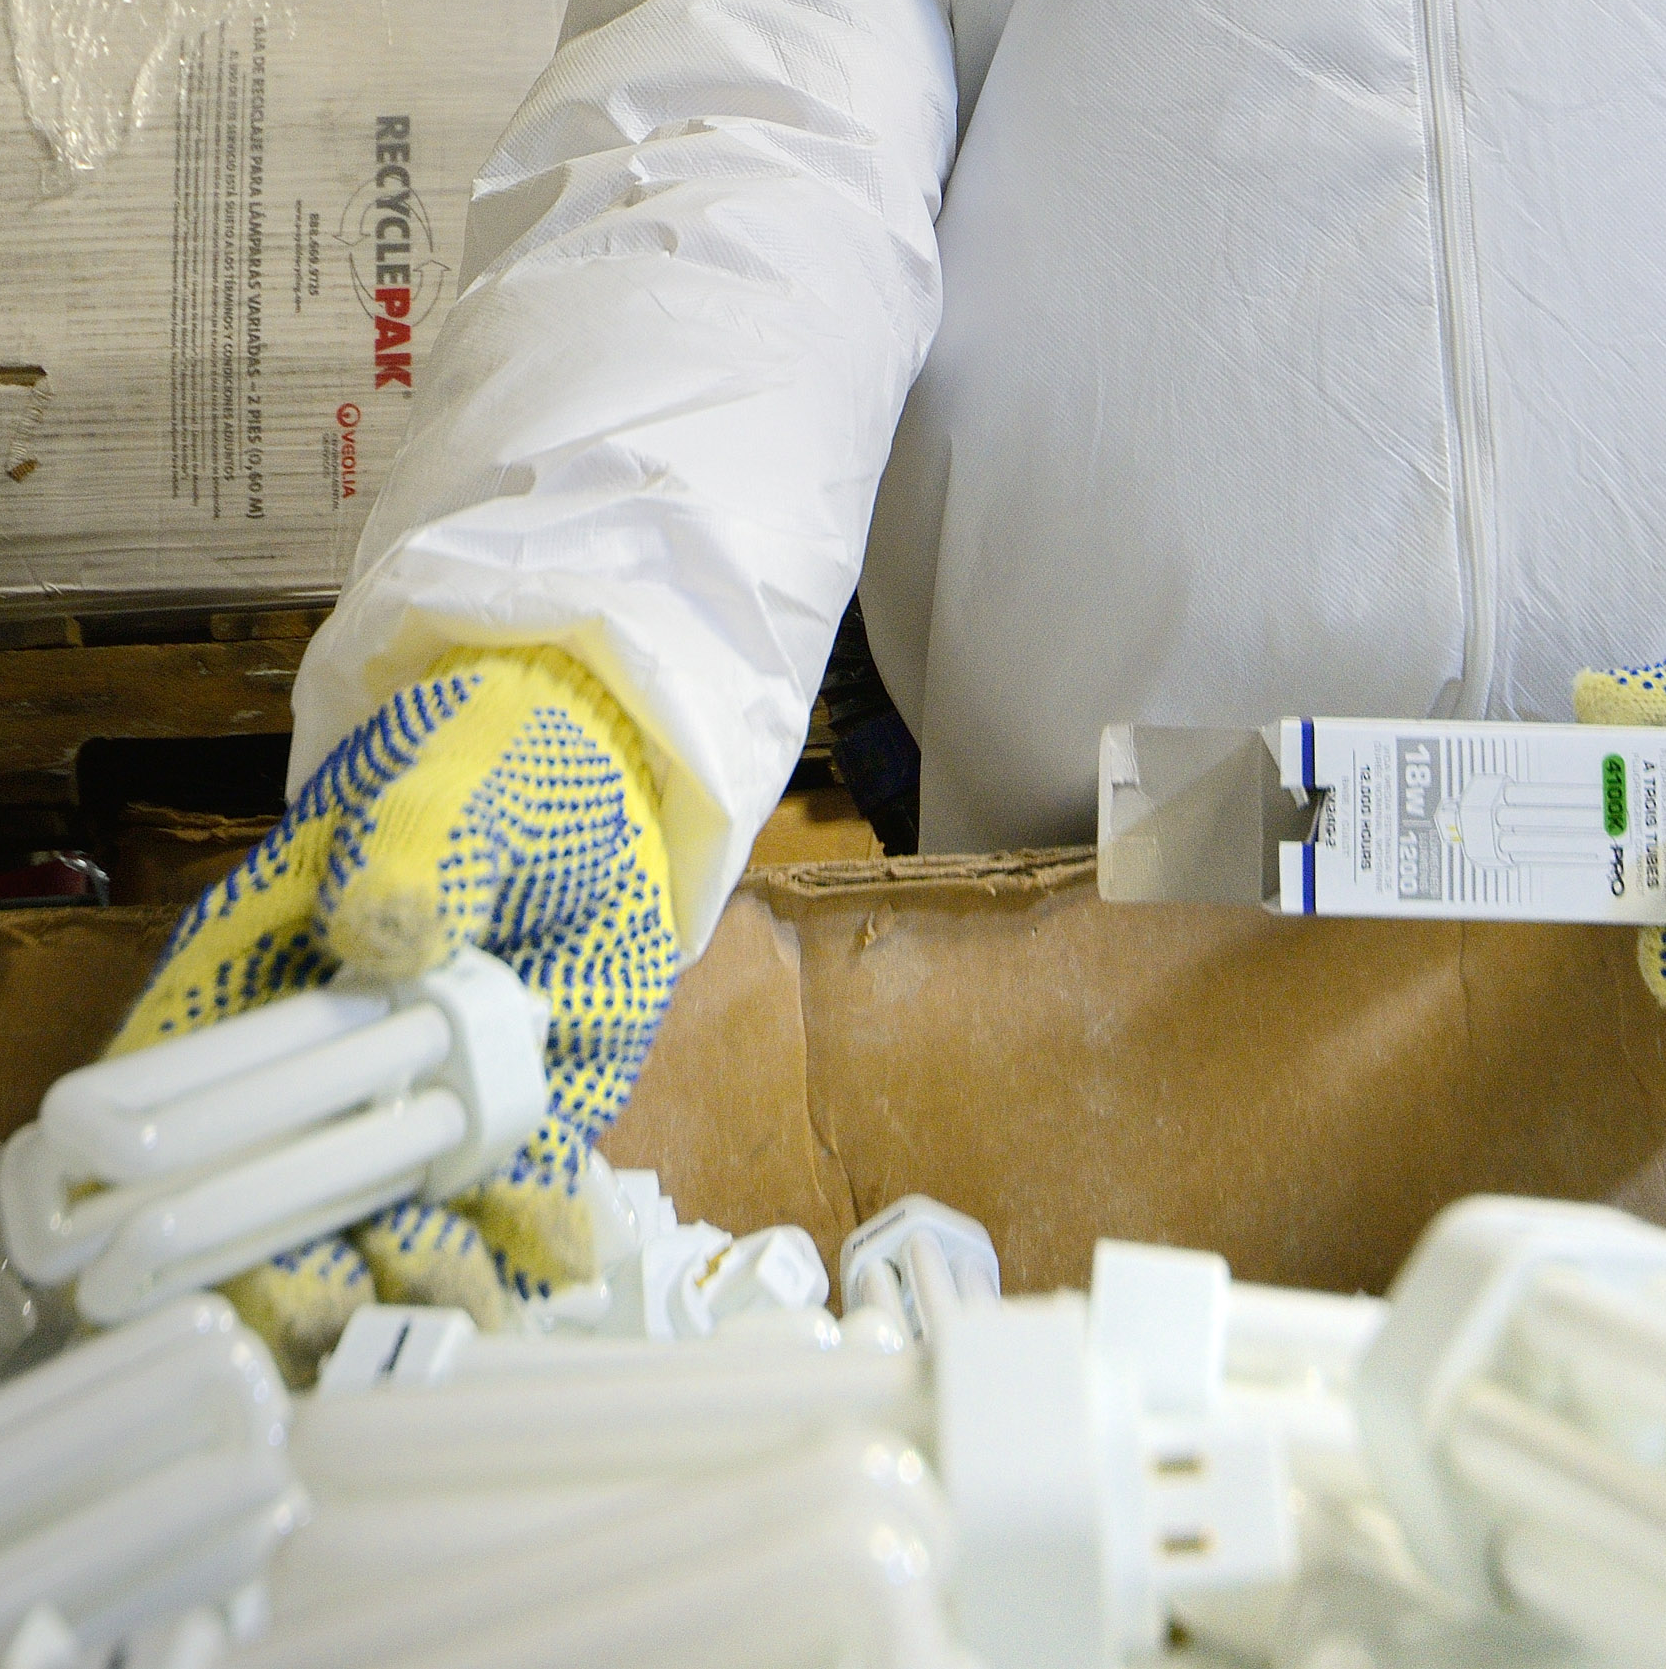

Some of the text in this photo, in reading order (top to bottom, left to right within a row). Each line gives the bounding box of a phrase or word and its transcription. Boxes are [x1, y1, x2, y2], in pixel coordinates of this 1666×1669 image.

[250, 77, 265, 151] RECICLAJE
[248, 153, 263, 197] PARA
[247, 201, 266, 292] LÁMPARAS
[374, 114, 412, 390] RECYCLEPAK
[246, 293, 262, 377] VARIADAS
[246, 408, 262, 444] PIES
[340, 429, 357, 499] VEOLIA
[1606, 760, 1626, 897] 4100K PRO
[1644, 778, 1657, 827] TROIS
[1360, 818, 1371, 871] HOURS
[1398, 831, 1418, 893] 1200
[1645, 833, 1660, 889] TUBES
